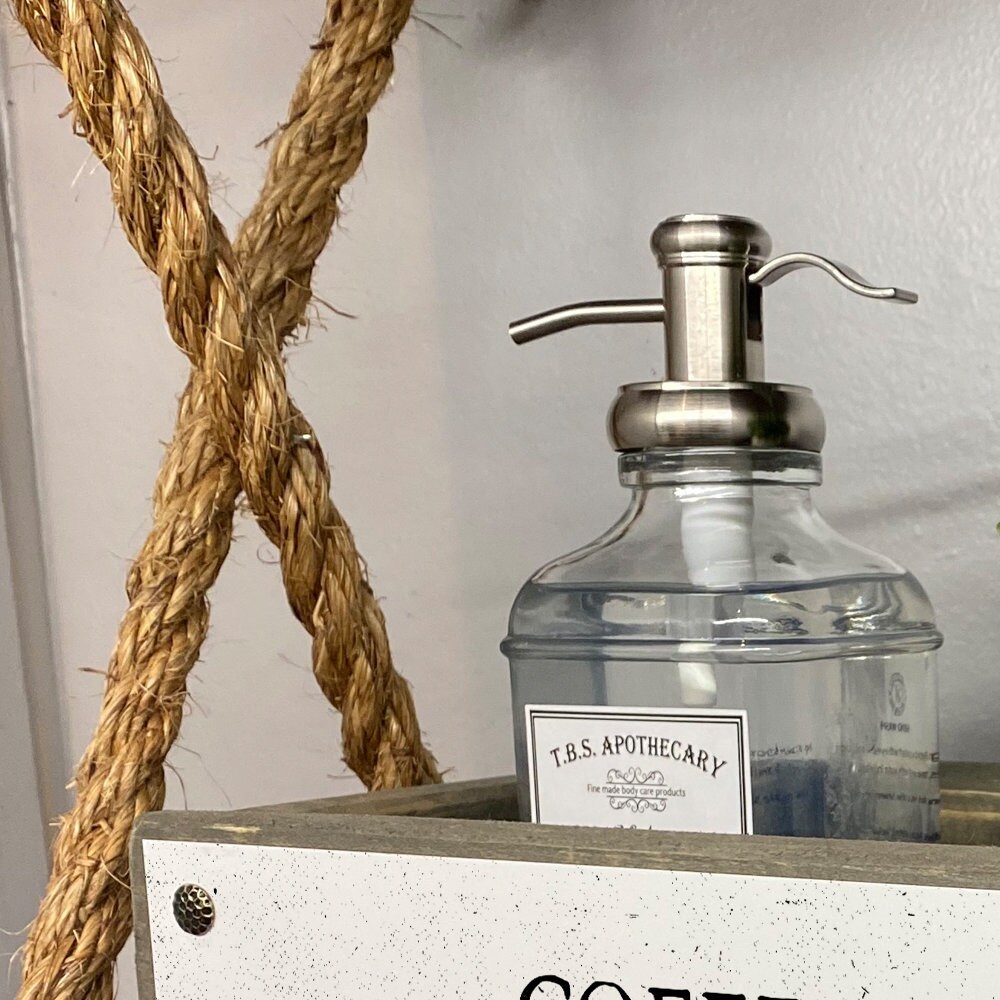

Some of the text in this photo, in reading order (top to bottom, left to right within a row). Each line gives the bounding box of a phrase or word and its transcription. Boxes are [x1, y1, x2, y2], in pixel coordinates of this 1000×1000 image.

[549, 734, 727, 779] T.B.S. APOTHECARY
[586, 783, 686, 798] Fine made body care products
